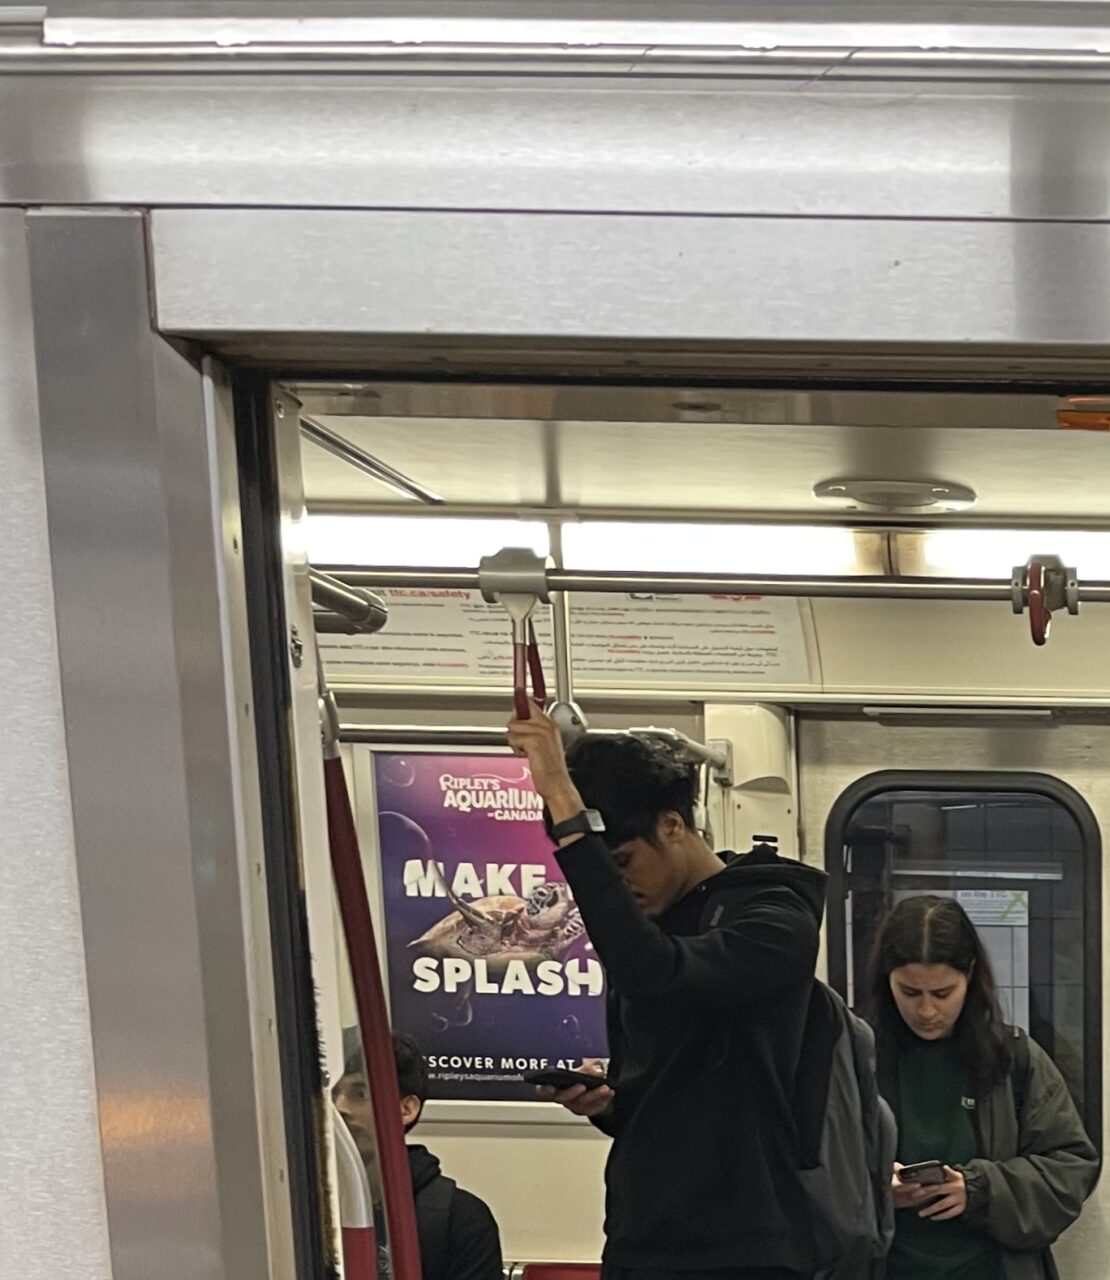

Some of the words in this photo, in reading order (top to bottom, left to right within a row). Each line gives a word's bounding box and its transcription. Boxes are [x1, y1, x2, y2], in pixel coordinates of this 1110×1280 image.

[389, 588, 470, 600] ttc.ca/safety
[443, 787, 544, 812] AQUARIUM
[403, 858, 546, 899] MAKE
[412, 956, 603, 996] SPLASH
[422, 1055, 494, 1070] SCOVER
[556, 1059, 575, 1071] AT
